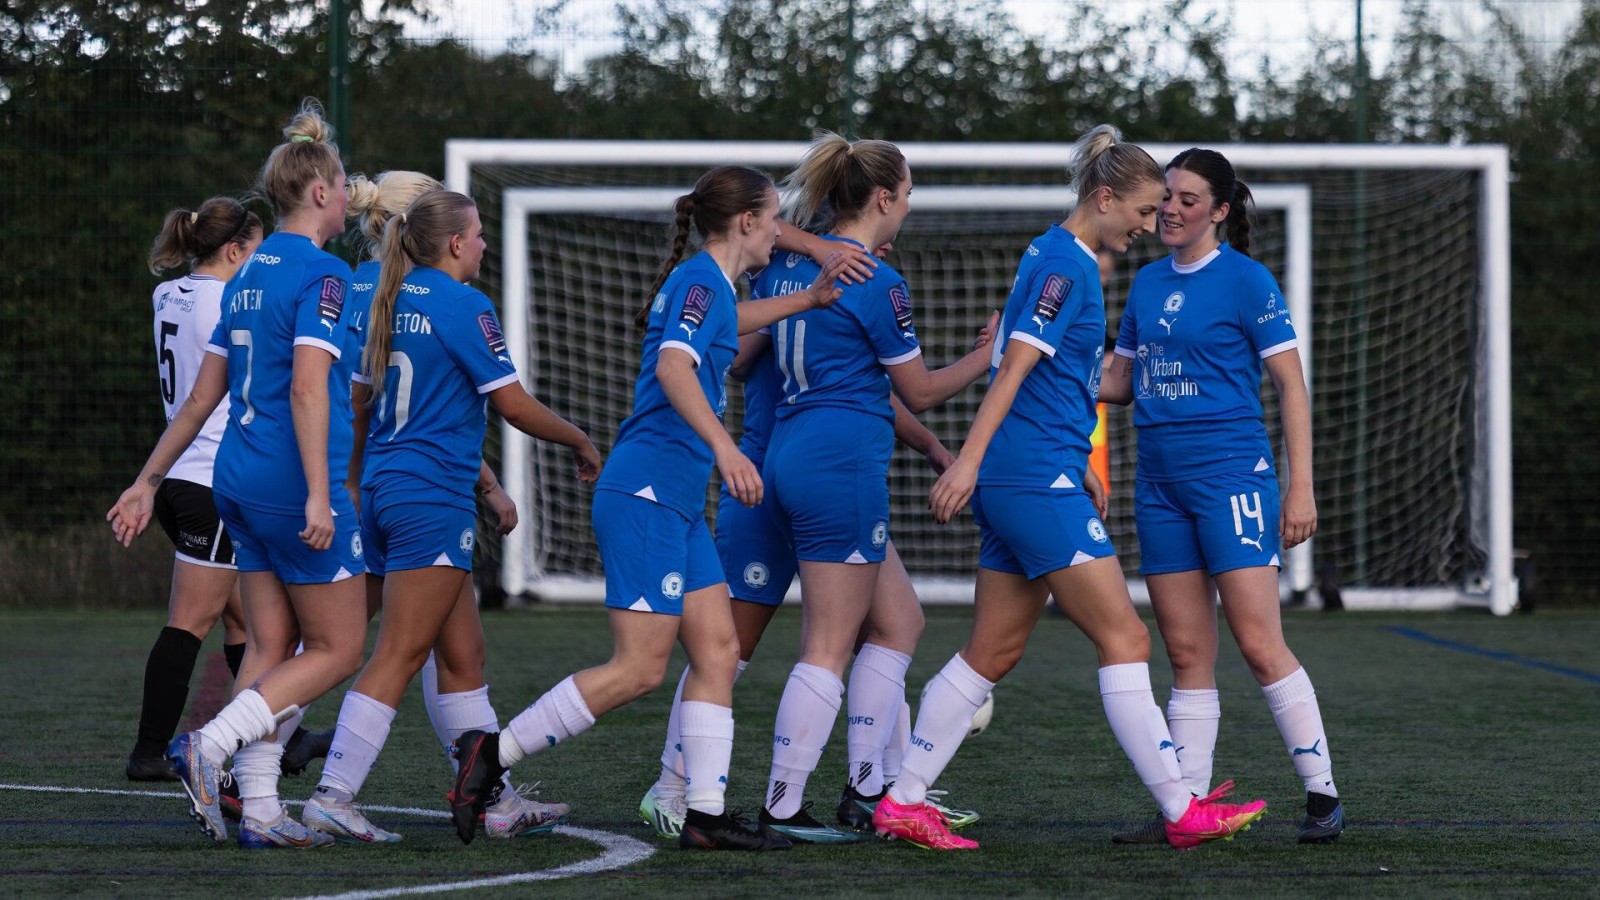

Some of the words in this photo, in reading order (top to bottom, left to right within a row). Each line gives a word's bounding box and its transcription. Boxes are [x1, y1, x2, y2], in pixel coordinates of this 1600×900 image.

[254, 253, 281, 265] PROP
[401, 283, 430, 295] PROP
[391, 313, 432, 335] ETON
[1150, 342, 1164, 356] The
[160, 320, 179, 405] 5
[777, 318, 809, 405] 11
[1151, 358, 1182, 377] Urban
[231, 329, 255, 425] 7
[1230, 491, 1264, 536] 14
